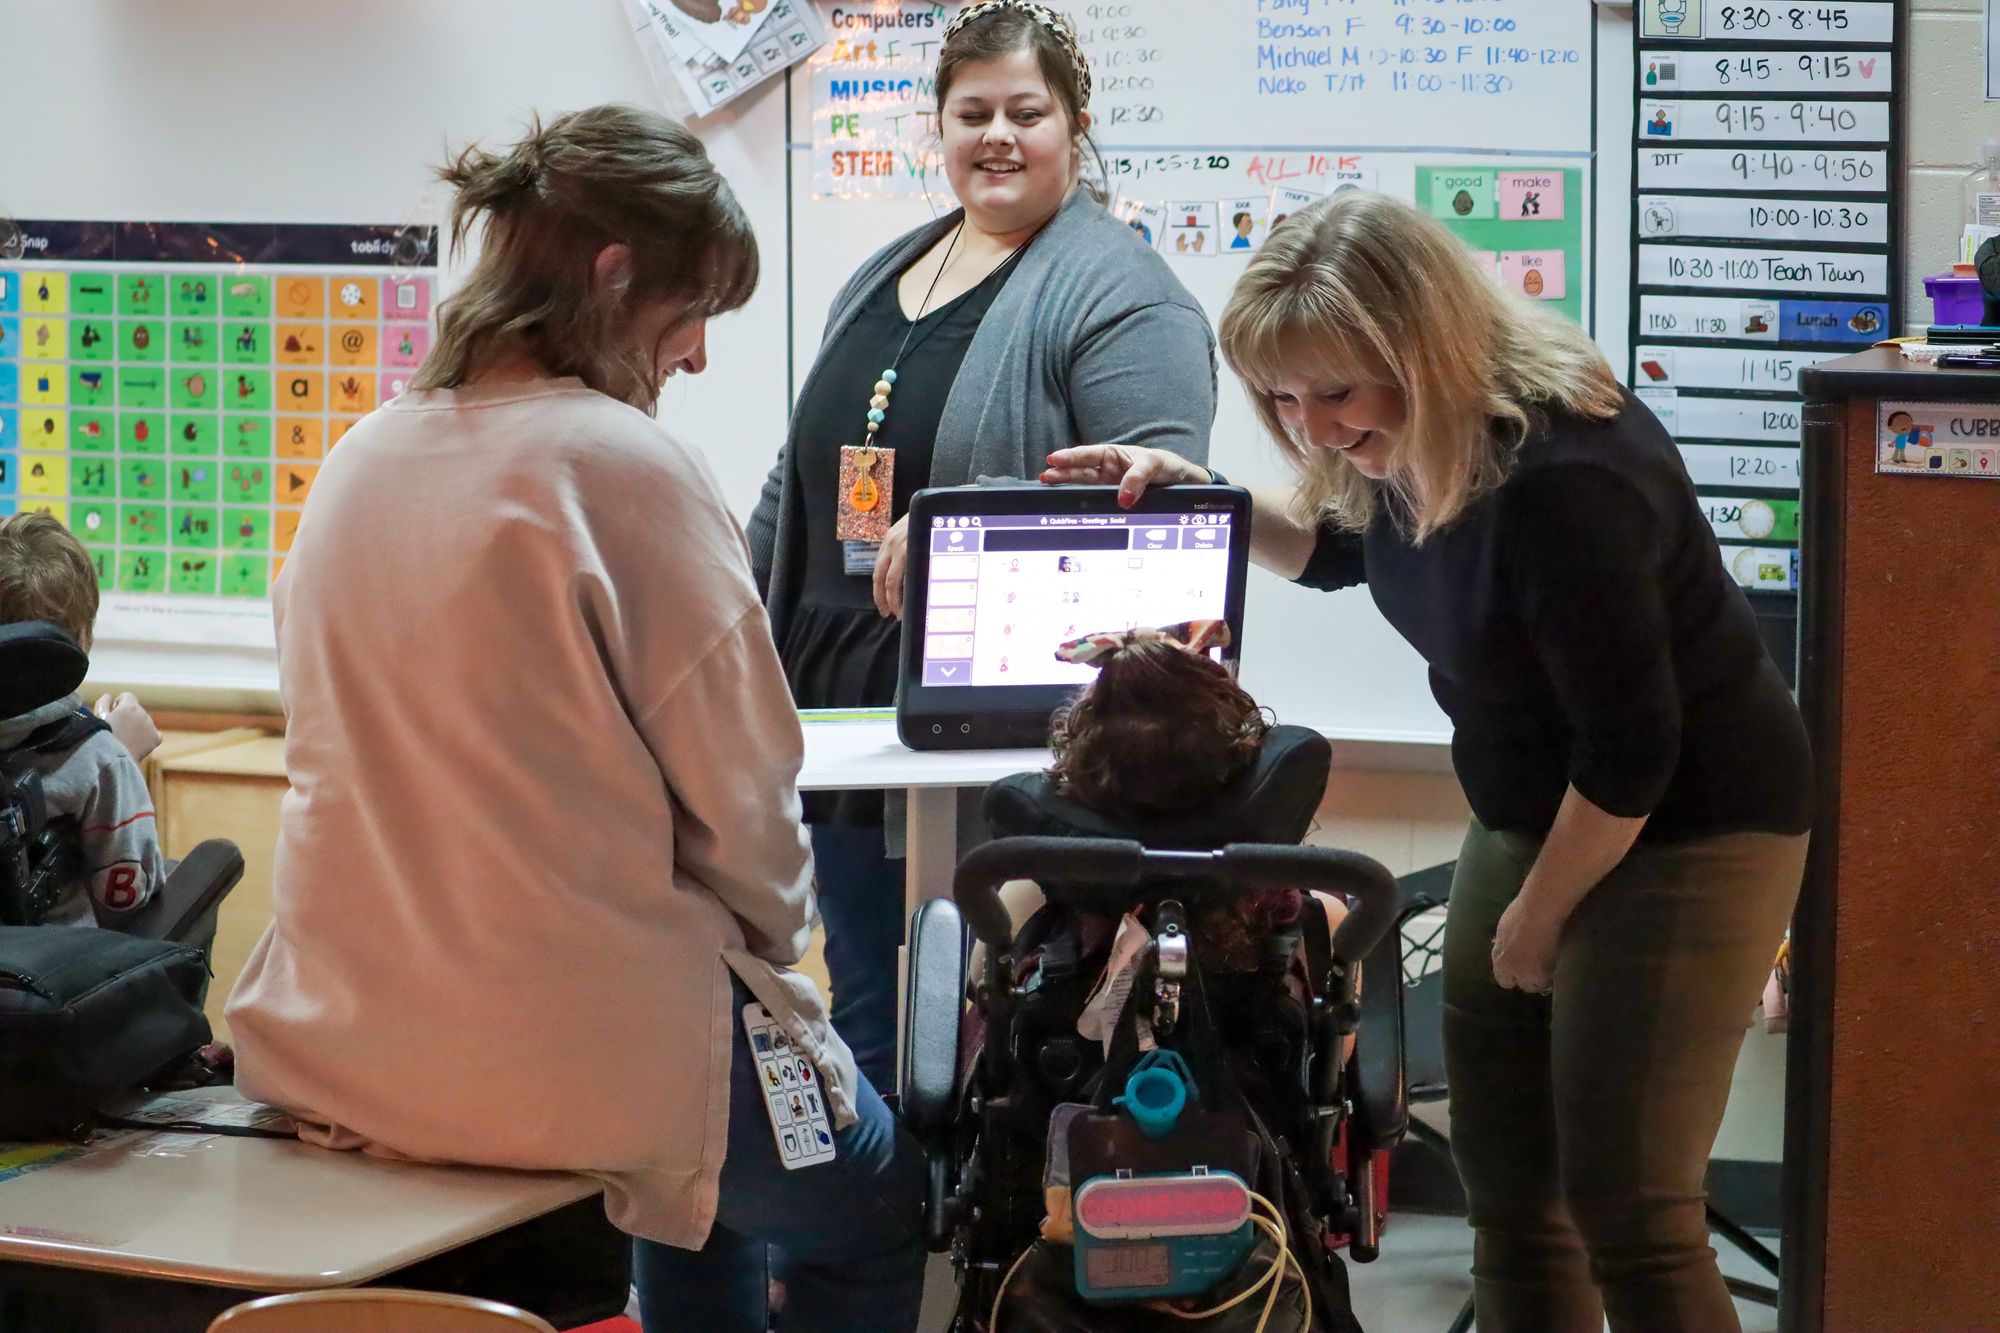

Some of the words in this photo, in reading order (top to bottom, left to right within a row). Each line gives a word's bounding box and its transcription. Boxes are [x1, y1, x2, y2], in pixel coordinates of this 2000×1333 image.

[832, 8, 934, 33] Computers
[1086, 4, 1132, 20] 9:00
[1102, 26, 1147, 41] 9:30
[1257, 18, 1331, 39] Benson
[1346, 17, 1365, 35] F
[831, 40, 877, 63] Art
[1258, 44, 1332, 70] Michael
[1341, 46, 1360, 66] M
[1457, 46, 1472, 63] F
[830, 79, 914, 101] MUSIC
[1101, 76, 1154, 92] 12:00
[831, 113, 860, 138] PE
[831, 150, 893, 177] STEM
[1652, 152, 1684, 166] DTT
[1247, 155, 1301, 185] ALL
[1445, 175, 1482, 189] good
[1512, 176, 1551, 188] make
[1180, 204, 1202, 212] want
[1521, 256, 1543, 267] like
[1760, 257, 1812, 282] Teach
[1817, 262, 1865, 284] Town
[1796, 312, 1838, 328] Lunch
[1763, 411, 1799, 430] 12:00
[1110, 516, 1126, 524] Social
[104, 866, 137, 909] B
